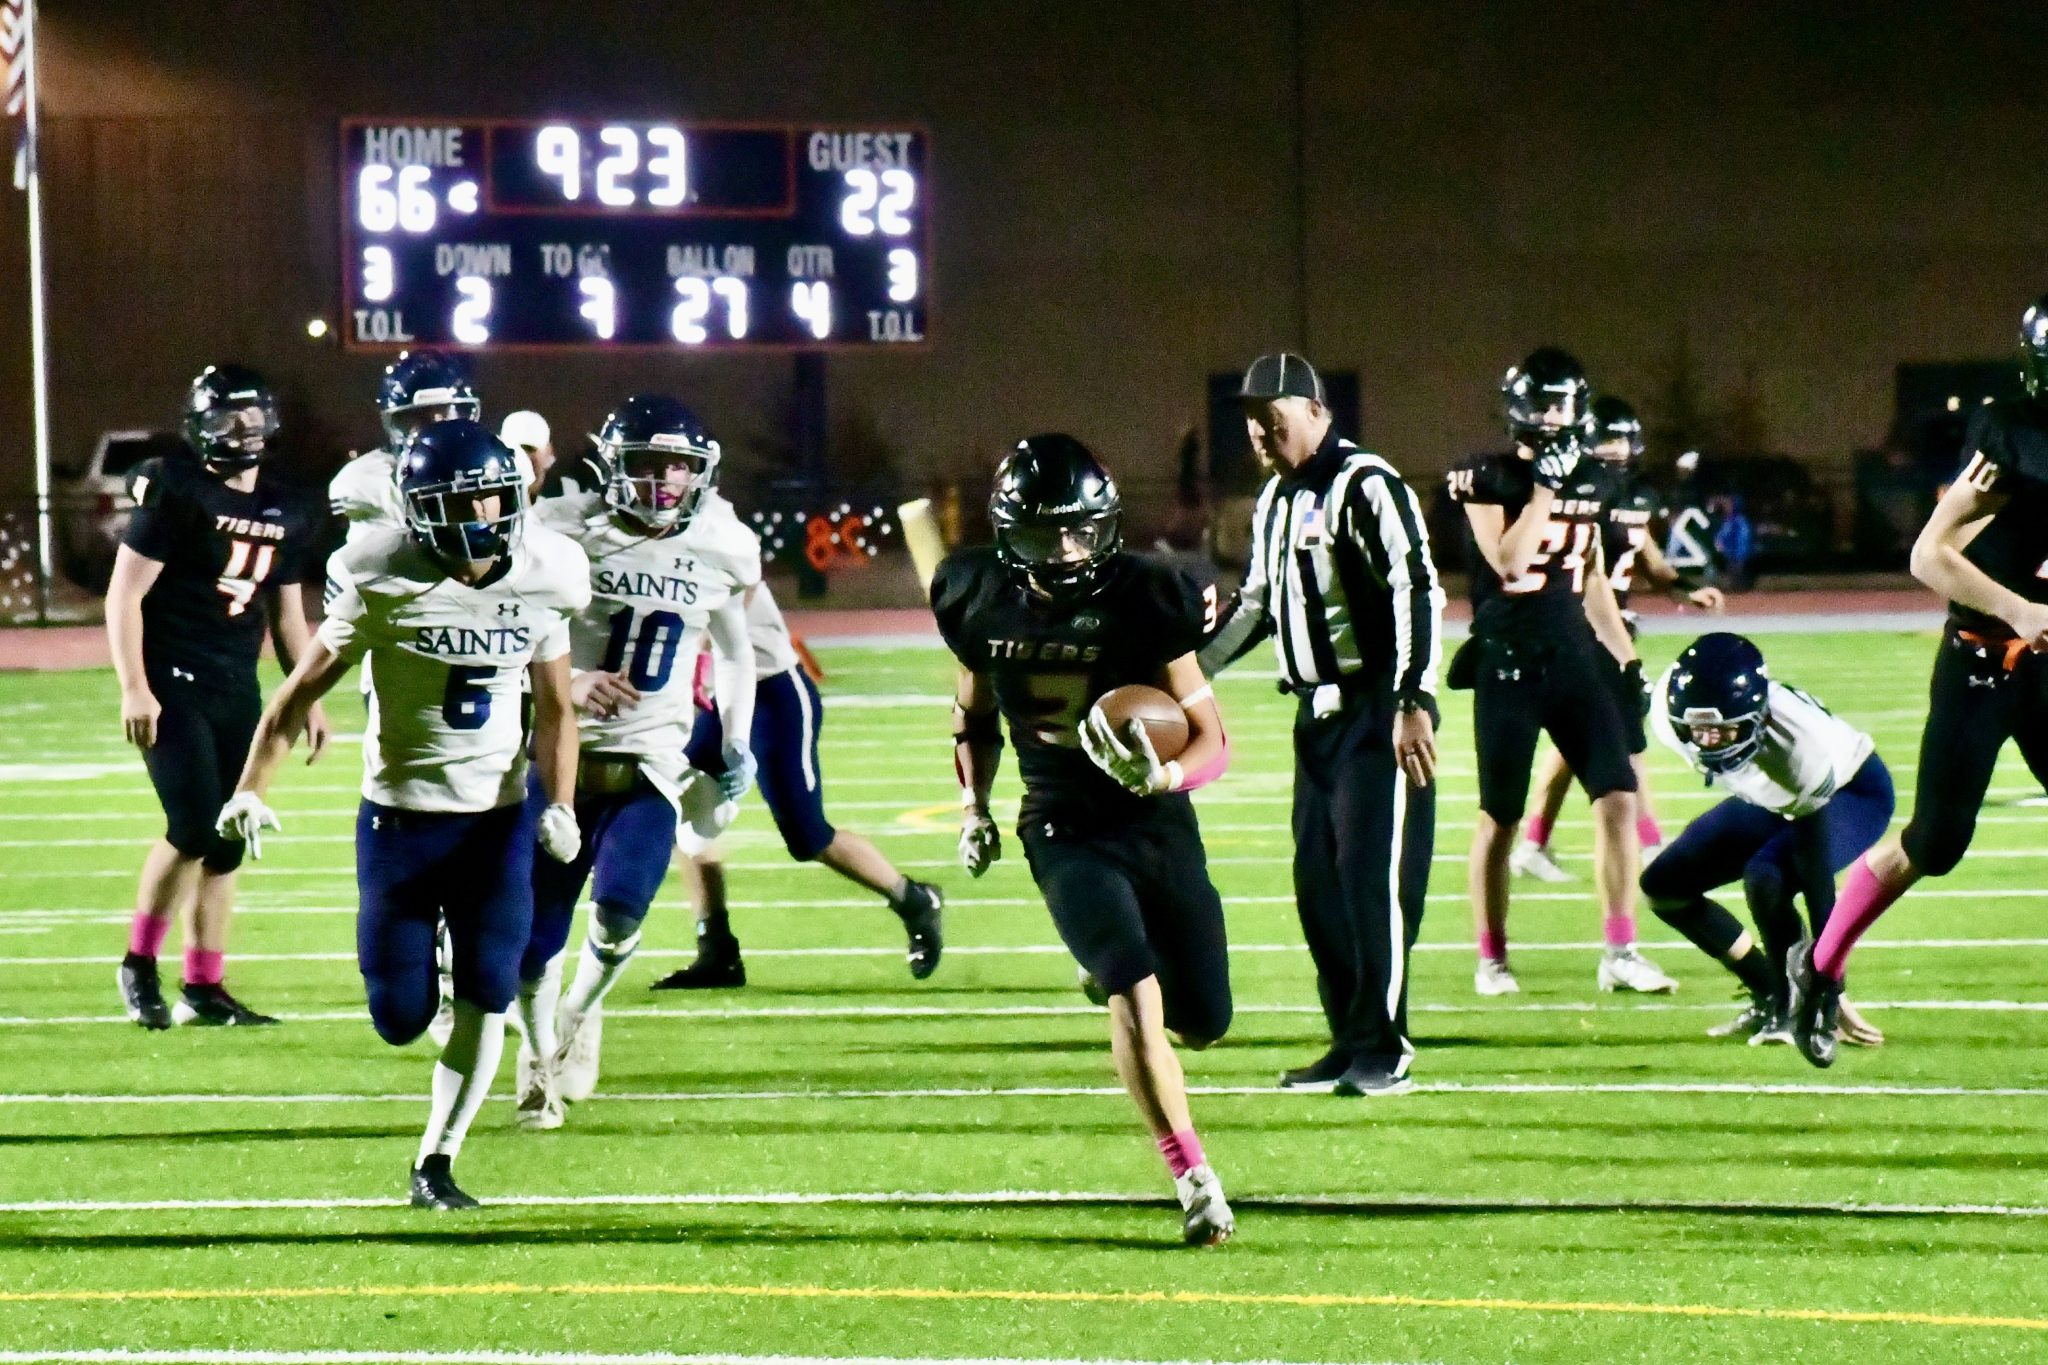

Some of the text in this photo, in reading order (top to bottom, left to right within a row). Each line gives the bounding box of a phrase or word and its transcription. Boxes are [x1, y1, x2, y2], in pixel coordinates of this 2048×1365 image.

[366, 127, 464, 167] HOME
[808, 132, 912, 171] GUEST
[359, 165, 436, 232] 66
[842, 169, 914, 235] 22
[363, 246, 392, 302] 3
[436, 243, 511, 276] DOWN
[541, 244, 573, 276] TO
[724, 245, 754, 276] ON
[787, 244, 835, 277] QTR
[888, 248, 917, 302] 3
[453, 276, 491, 344] 2
[672, 276, 748, 343] 27
[792, 281, 830, 339] 4
[215, 514, 286, 541] TIGERS
[597, 570, 699, 606] SAINTS
[1201, 583, 1218, 634] 3
[415, 626, 530, 655] SAINTS
[599, 603, 686, 693] 10
[441, 664, 493, 730] 6
